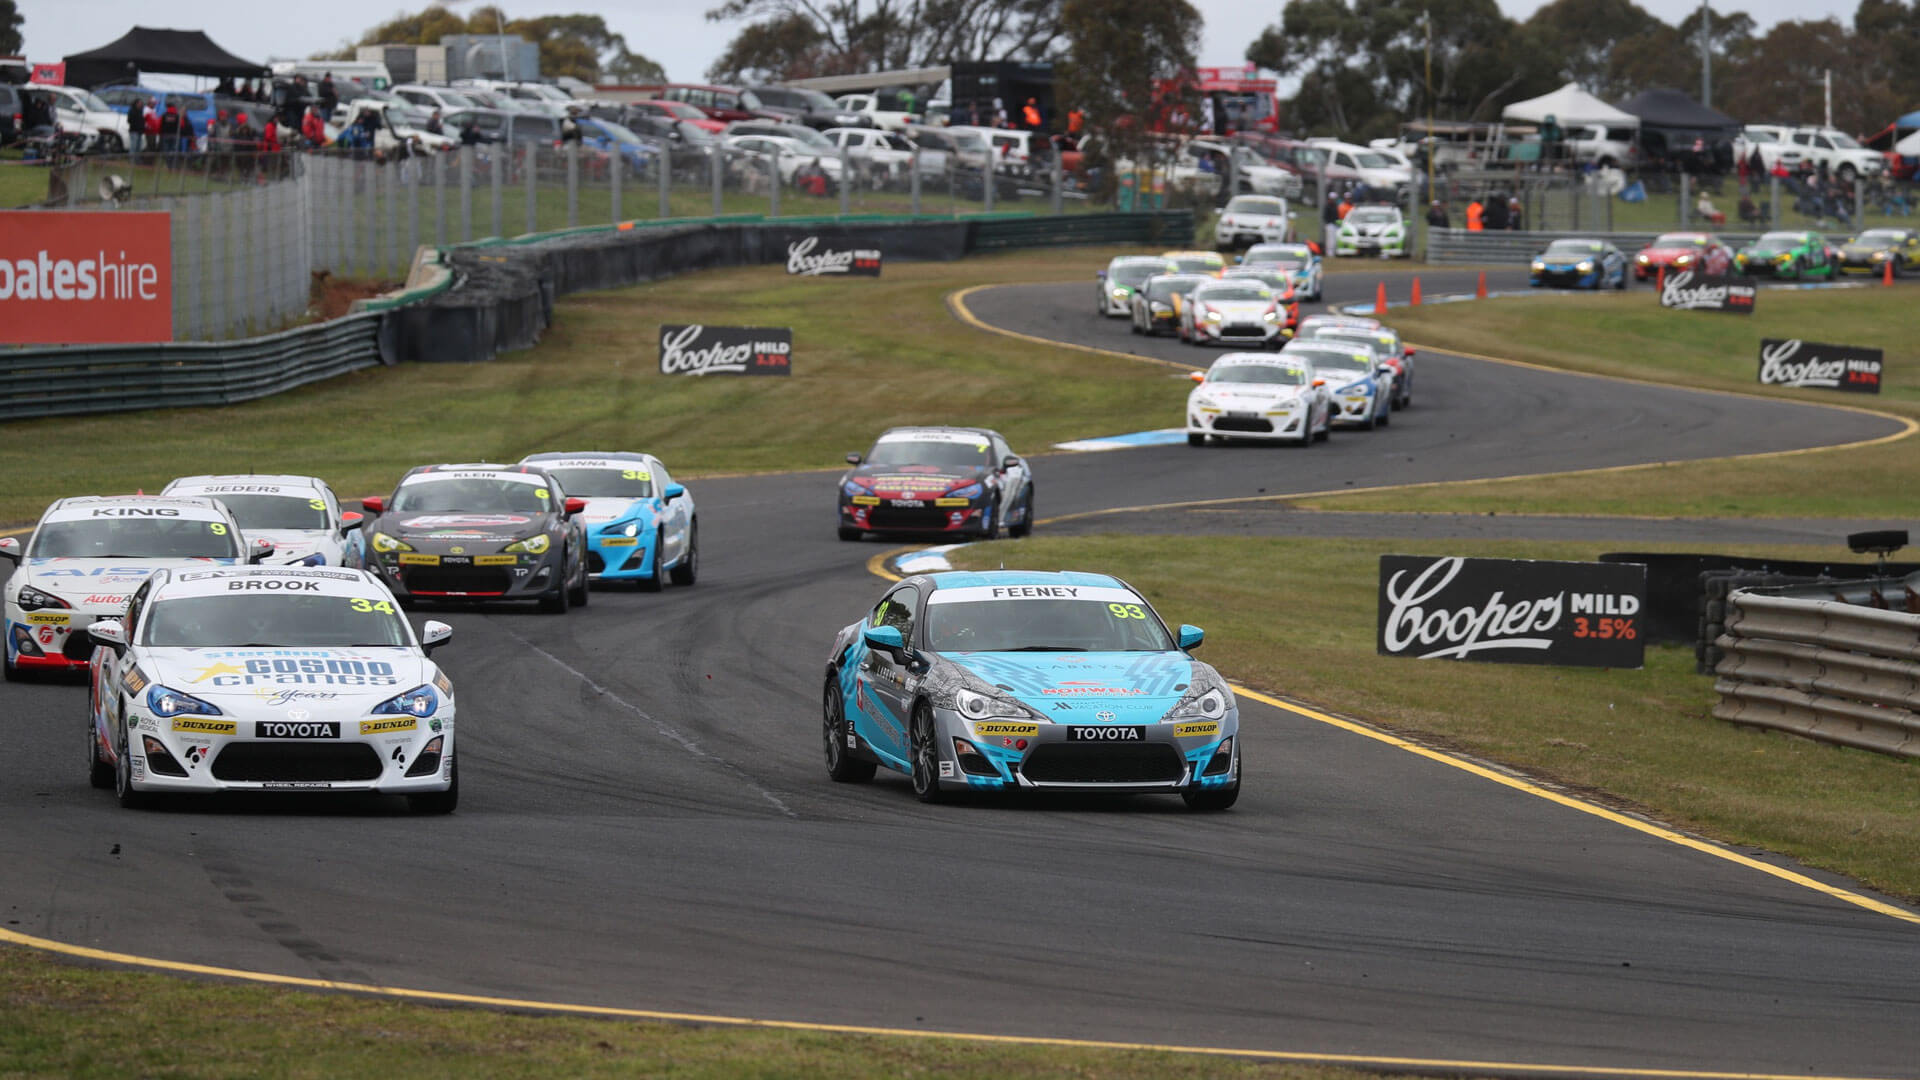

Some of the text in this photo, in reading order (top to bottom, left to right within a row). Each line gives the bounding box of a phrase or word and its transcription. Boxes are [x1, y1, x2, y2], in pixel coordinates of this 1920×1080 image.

[787, 236, 853, 275] Coopers
[1662, 270, 1728, 309] Coopers
[662, 324, 790, 376] Coopers MILD
[1760, 339, 1880, 387] Coopers MILD
[622, 470, 650, 482] 38
[204, 485, 280, 493] SIEDERS
[535, 488, 550, 500] 6
[309, 499, 327, 511] 3
[890, 499, 925, 508] TOYOTA
[92, 507, 179, 517] KING
[210, 523, 227, 535] 9
[37, 567, 152, 576] AIS
[228, 580, 320, 592] BROOK
[993, 587, 1079, 598] FEENEY
[350, 598, 395, 615] 34
[1109, 603, 1146, 620] 93
[1384, 557, 1639, 658] Coopers MILD
[1574, 617, 1637, 640] 3.5%
[1042, 687, 1149, 695] NORWELL
[182, 720, 235, 731] DUNLOP
[263, 723, 333, 737] TOYOTA
[373, 719, 416, 730] DUNLOP
[984, 725, 1036, 733] DUNLOP
[1183, 724, 1218, 733] DUNLOP
[1074, 727, 1139, 740] TOYOTA
